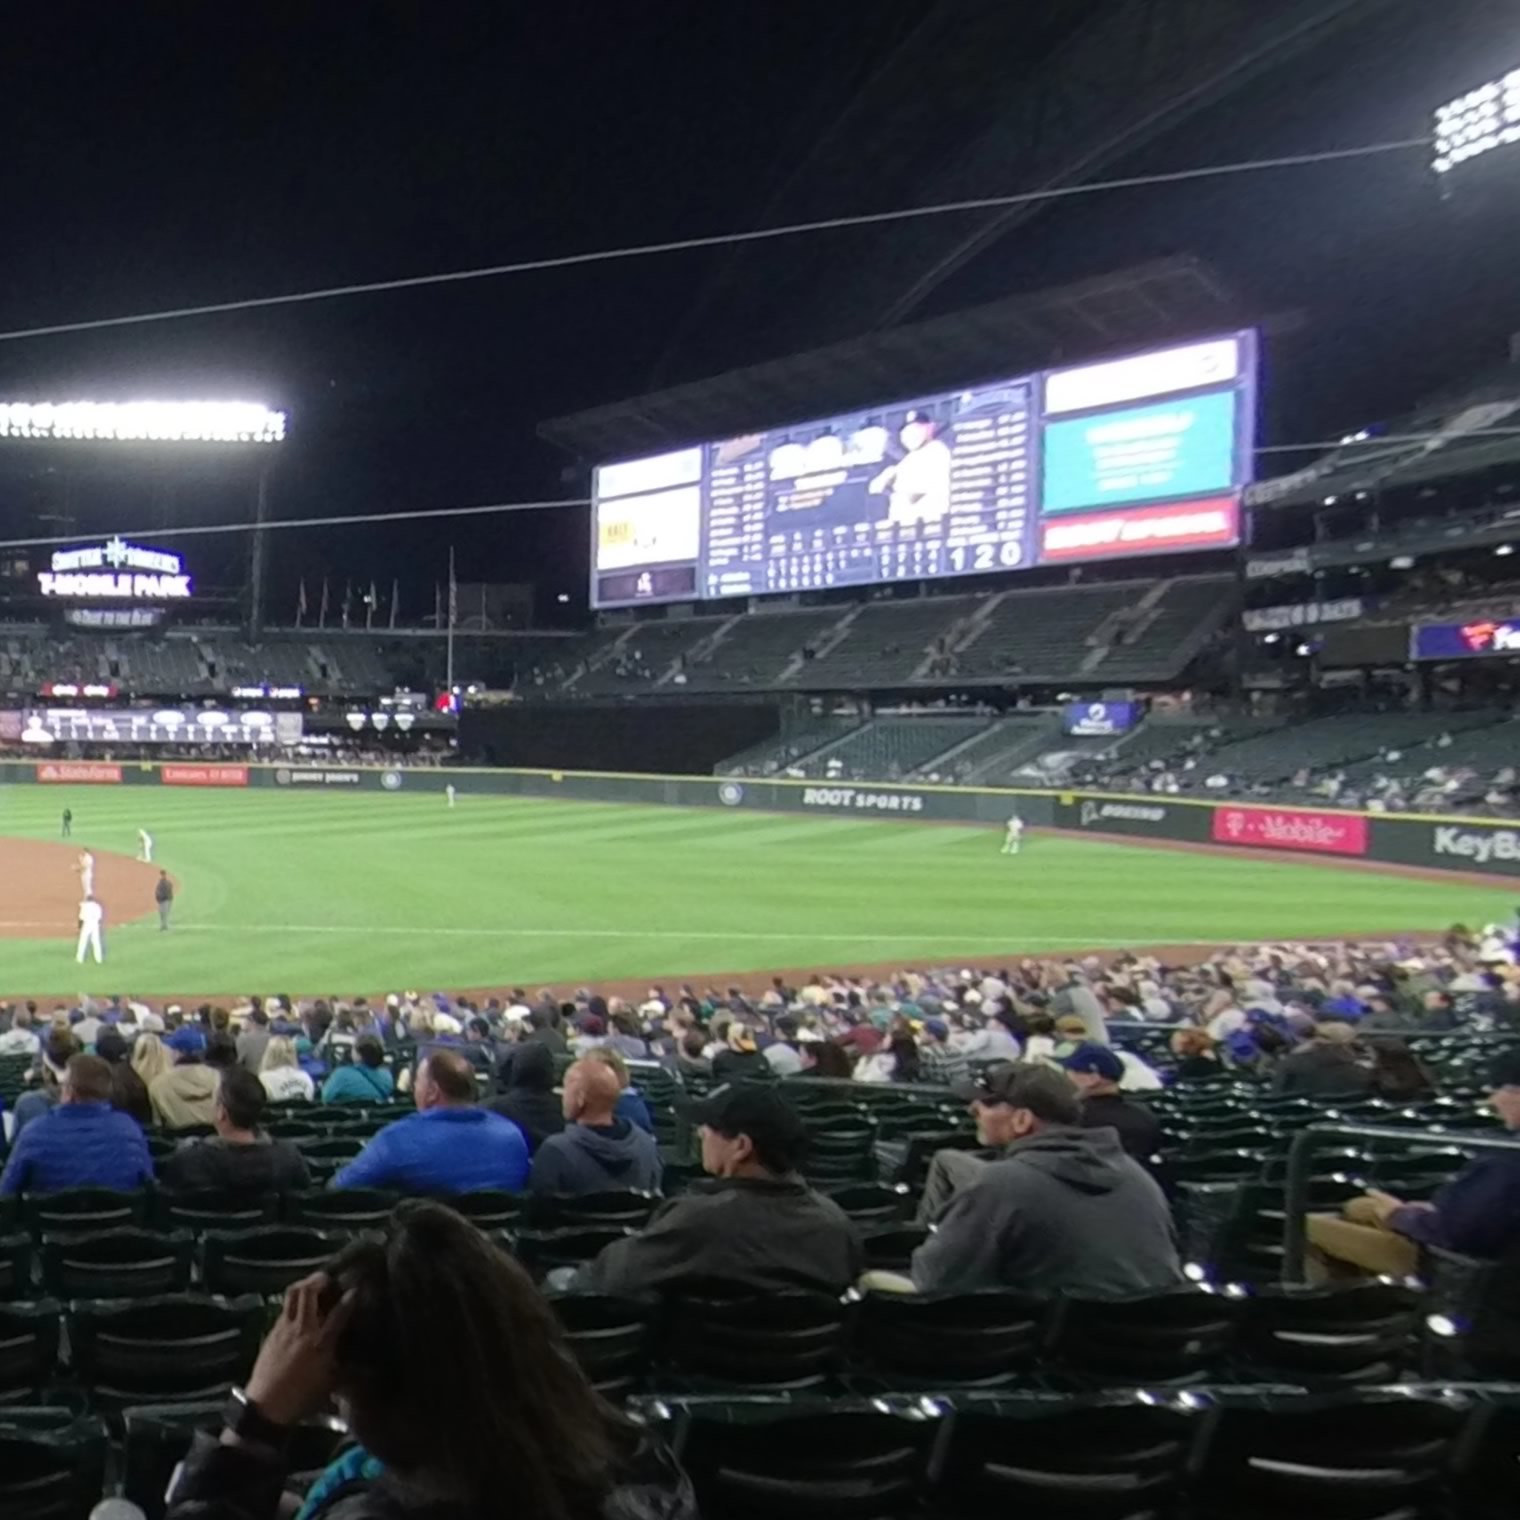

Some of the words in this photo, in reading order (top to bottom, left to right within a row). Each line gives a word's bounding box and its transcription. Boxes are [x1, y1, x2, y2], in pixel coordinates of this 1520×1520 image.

[950, 547, 964, 571] 1
[974, 544, 995, 569] 2
[1000, 541, 1021, 566] 0
[37, 573, 132, 596] T-MOBILE
[134, 574, 192, 597] PARK
[803, 788, 856, 806] ROOT
[854, 793, 922, 811] SPORTS
[1435, 826, 1520, 862] KeyB
